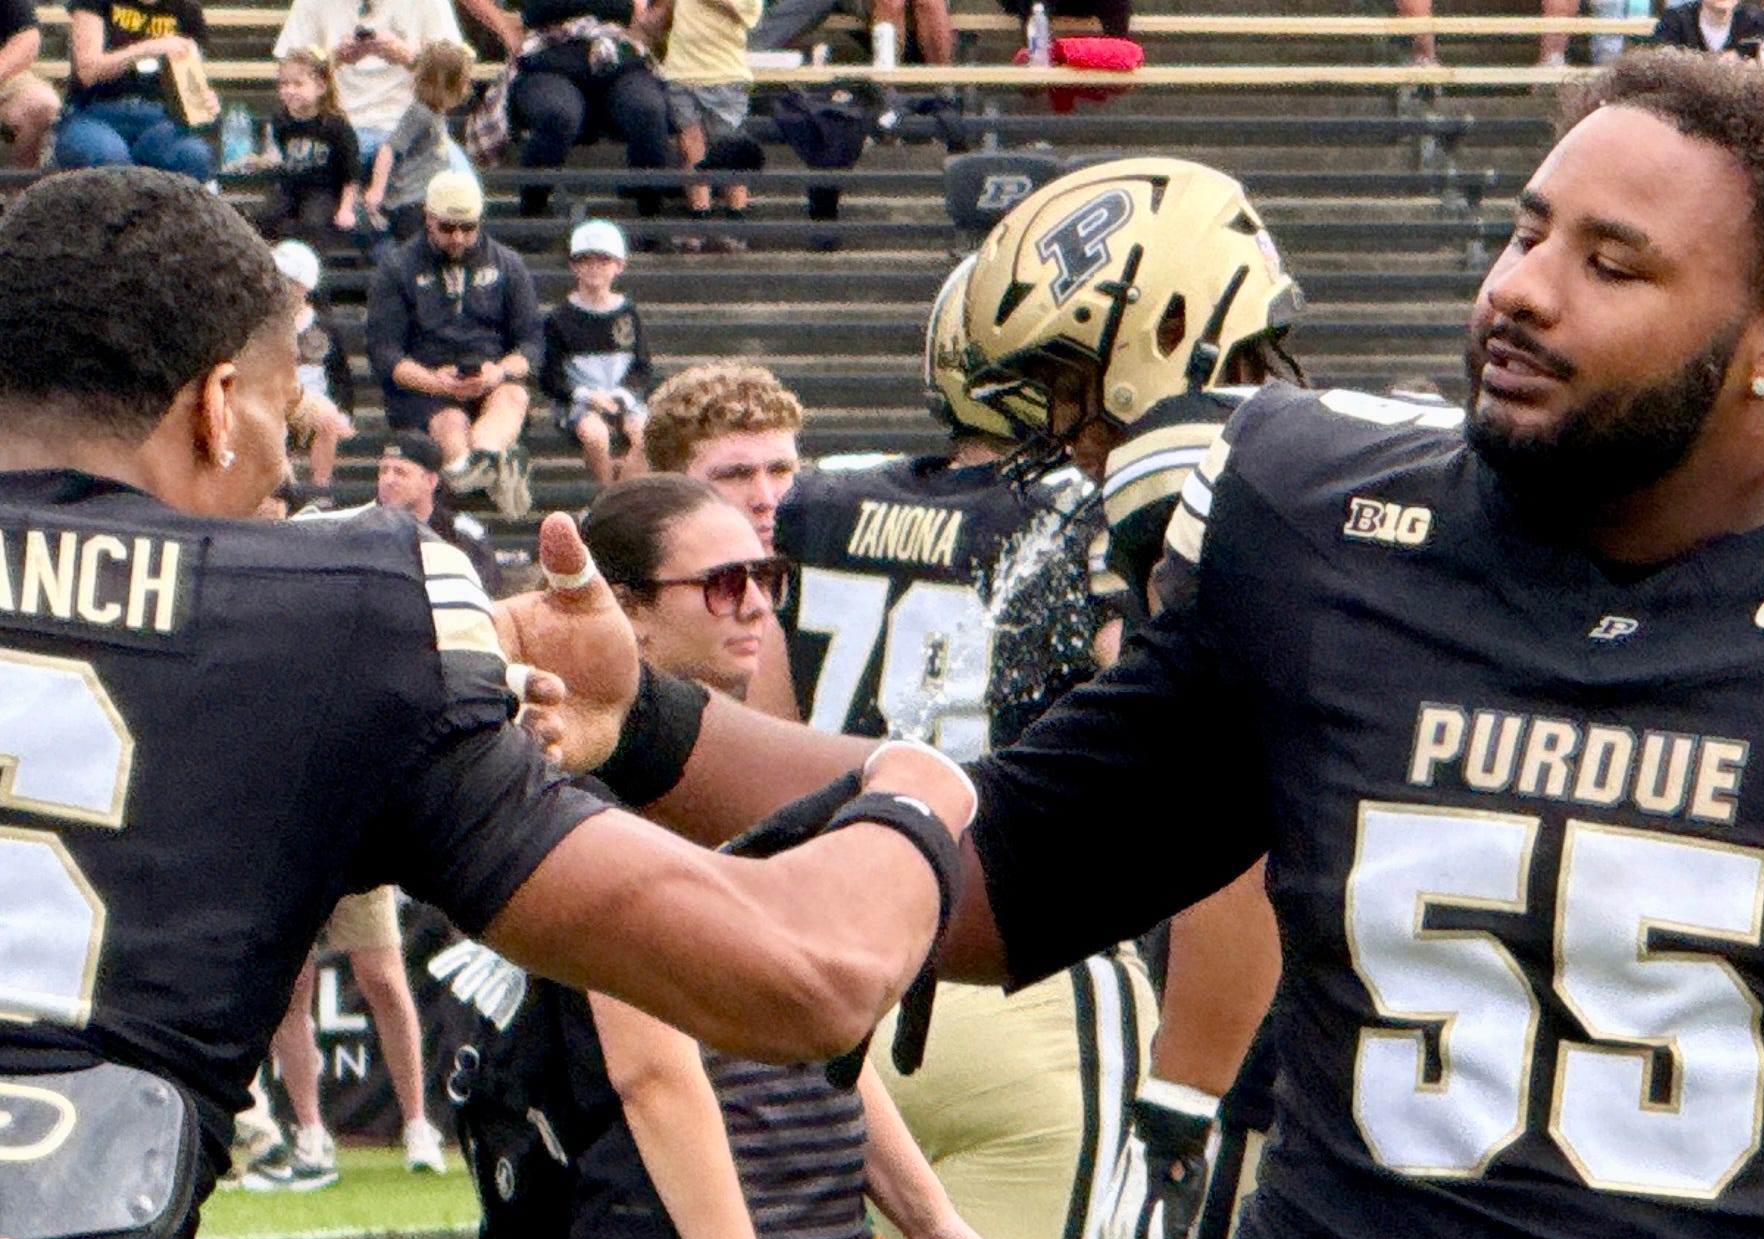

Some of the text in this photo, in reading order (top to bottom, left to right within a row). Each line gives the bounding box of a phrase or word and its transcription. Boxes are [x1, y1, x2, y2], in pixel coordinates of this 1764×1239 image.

[1035, 189, 1134, 309] P
[848, 500, 963, 567] TANONA
[1588, 615, 1639, 639] P
[1406, 700, 1750, 827] PURDUE
